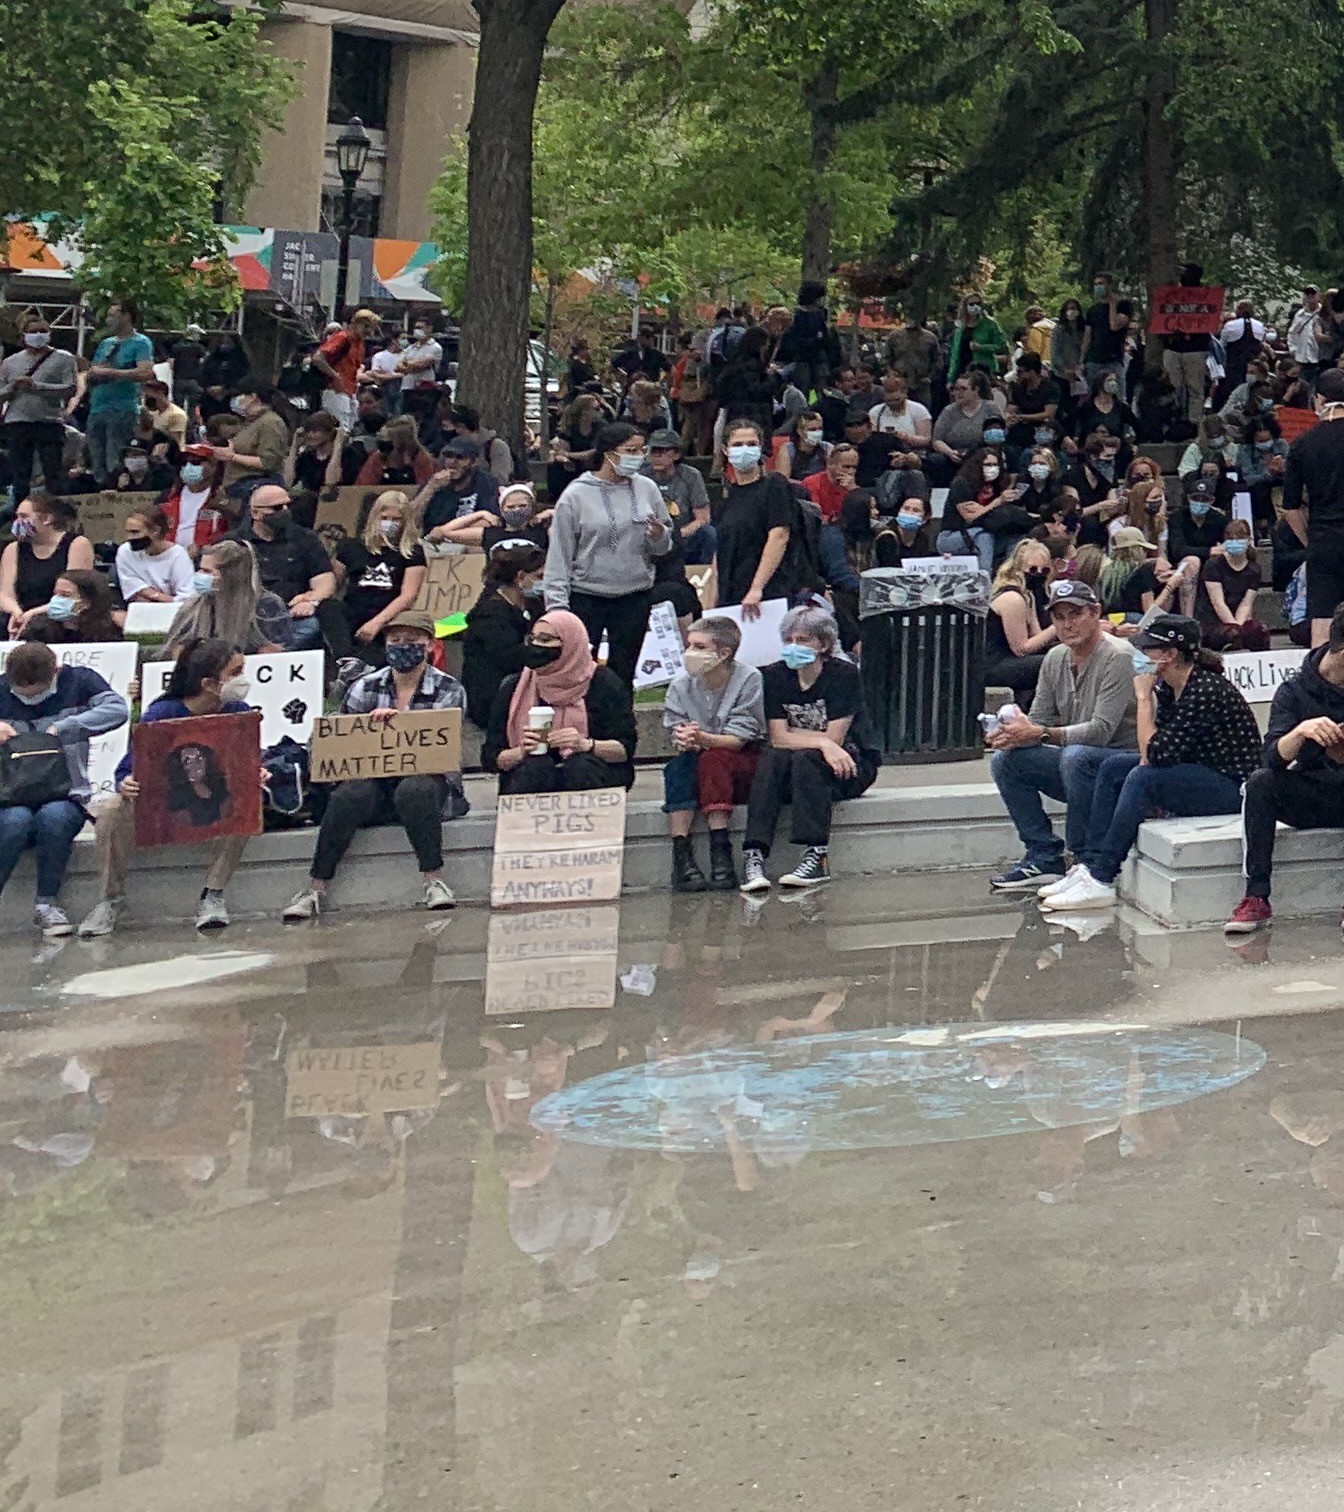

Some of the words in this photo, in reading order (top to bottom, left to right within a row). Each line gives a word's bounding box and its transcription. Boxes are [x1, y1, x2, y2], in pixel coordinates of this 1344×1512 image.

[162, 664, 306, 691] BCK
[1228, 665, 1256, 690] LACK
[317, 716, 398, 739] BLACK
[380, 726, 450, 751] LIVES
[318, 752, 418, 777] MATTER
[500, 794, 561, 814] NEVER
[567, 792, 621, 810] LIKED
[531, 812, 595, 835] PIGS
